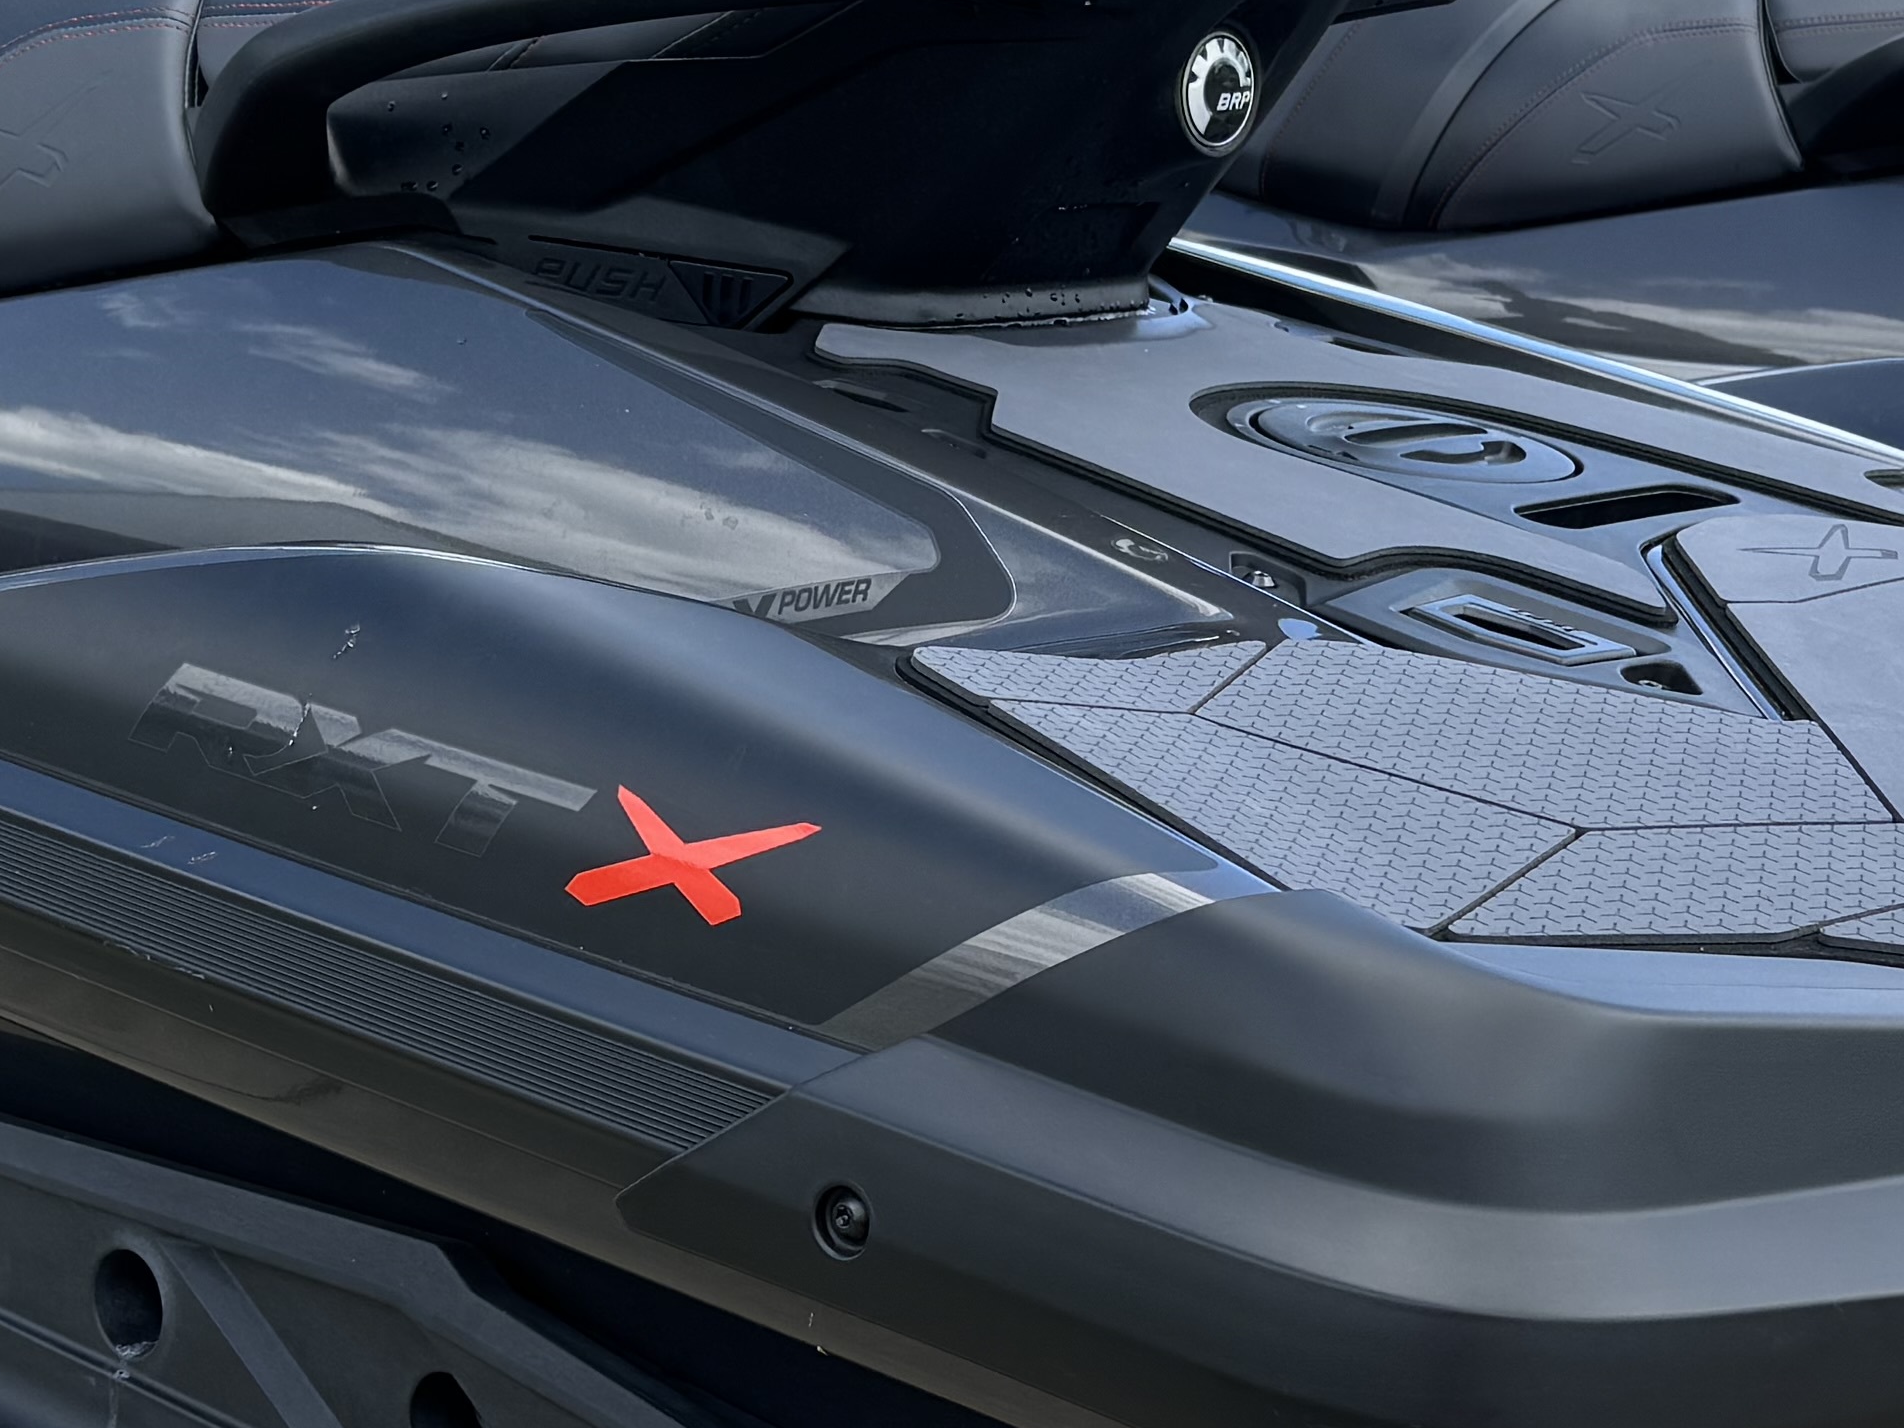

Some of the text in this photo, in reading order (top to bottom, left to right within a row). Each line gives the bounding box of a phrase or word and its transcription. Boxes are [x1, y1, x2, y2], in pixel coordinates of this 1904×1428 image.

[1216, 90, 1250, 111] BRP
[533, 256, 667, 303] PUSH
[777, 577, 873, 615] POWER
